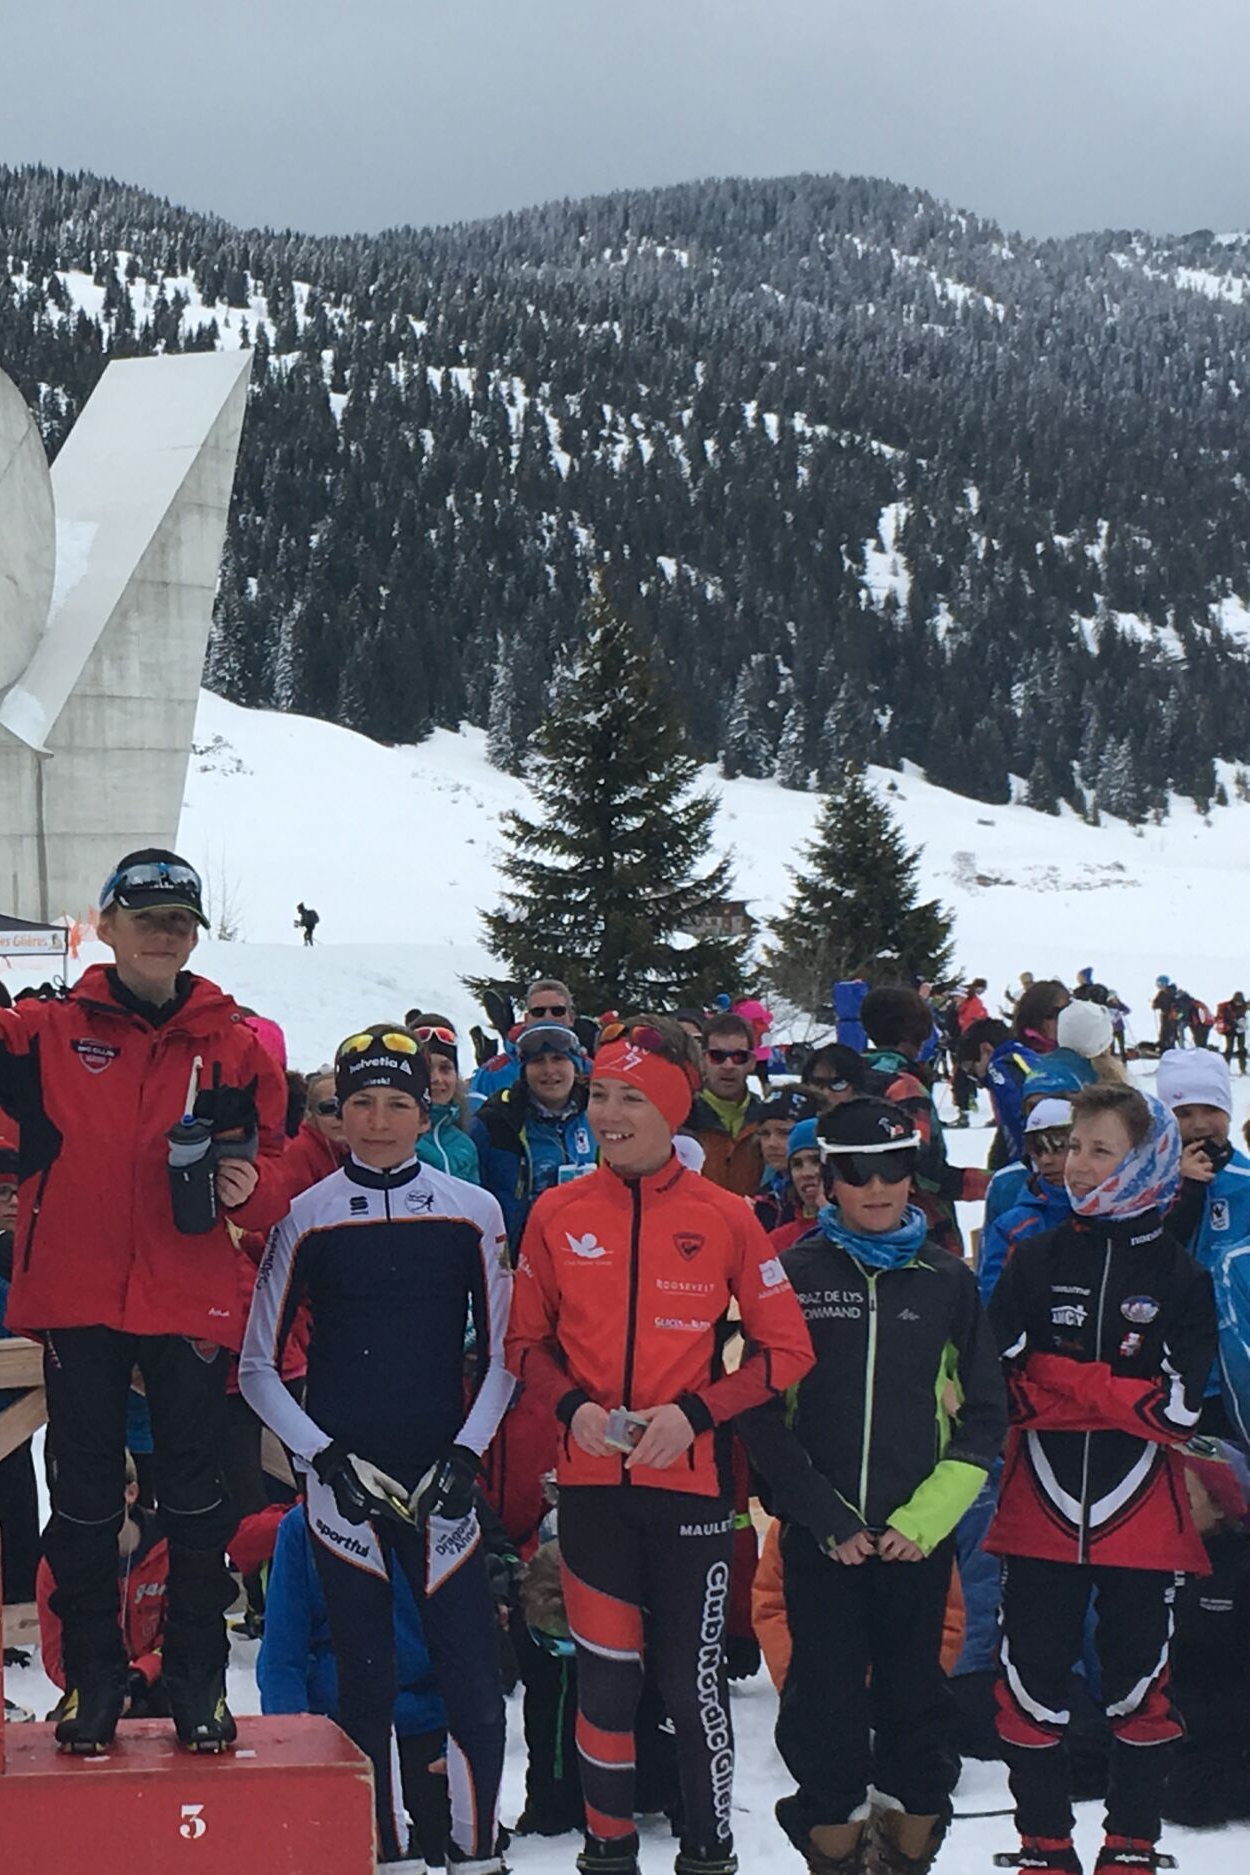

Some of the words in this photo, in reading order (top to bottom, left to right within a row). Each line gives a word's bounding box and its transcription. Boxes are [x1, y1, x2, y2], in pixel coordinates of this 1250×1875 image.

[349, 1056, 398, 1074] helvetia
[794, 1291, 821, 1305] RAZ
[824, 1291, 840, 1302] DE
[842, 1291, 864, 1303] LYS
[801, 1306, 862, 1320] OMMAND
[315, 1518, 370, 1559] sportful
[700, 1561, 729, 1645] Club
[697, 1643, 728, 1751] Nordic
[179, 1804, 207, 1839] 3
